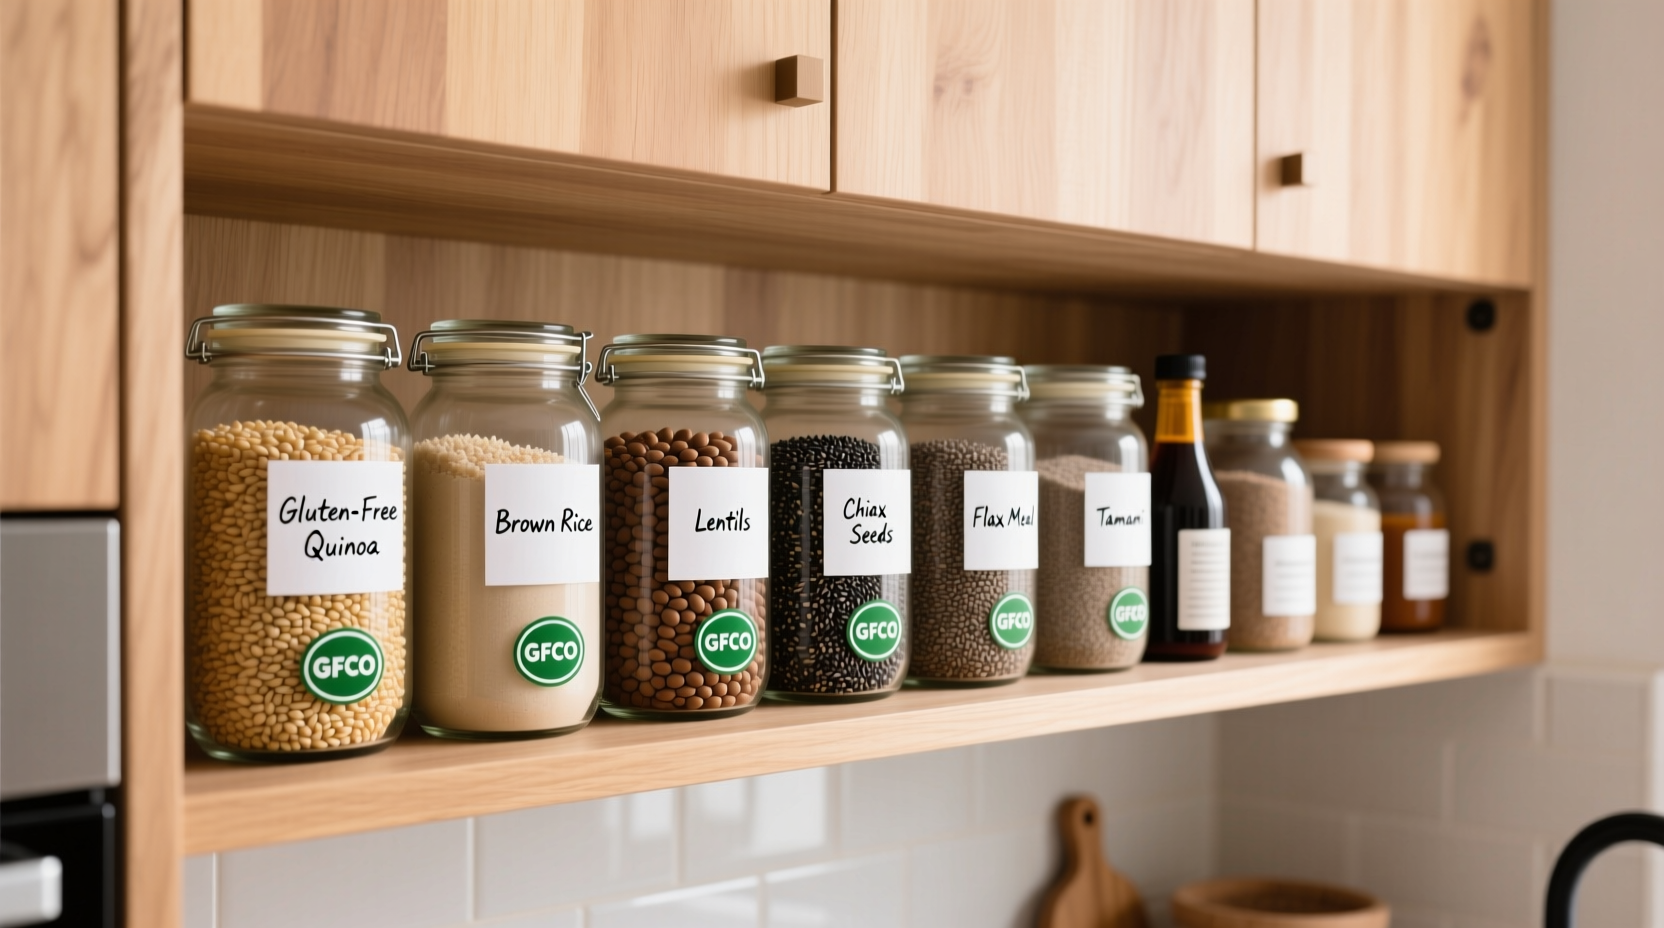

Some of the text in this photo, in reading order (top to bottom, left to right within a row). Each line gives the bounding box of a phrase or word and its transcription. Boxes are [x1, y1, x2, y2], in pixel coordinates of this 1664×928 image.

[278, 495, 398, 525] Gluten-Free
[843, 496, 887, 520] Chiax
[972, 505, 1034, 528] Flax Meal
[495, 507, 593, 535] Brown Rice
[694, 507, 751, 533] Lentils
[849, 522, 894, 545] Seeds
[303, 529, 380, 562] Quinoa
[855, 621, 898, 641] GFCO
[997, 611, 1031, 631] GFCO
[524, 640, 579, 663] GFCO
[704, 631, 752, 652] GFCO
[312, 654, 376, 679] GFCO
